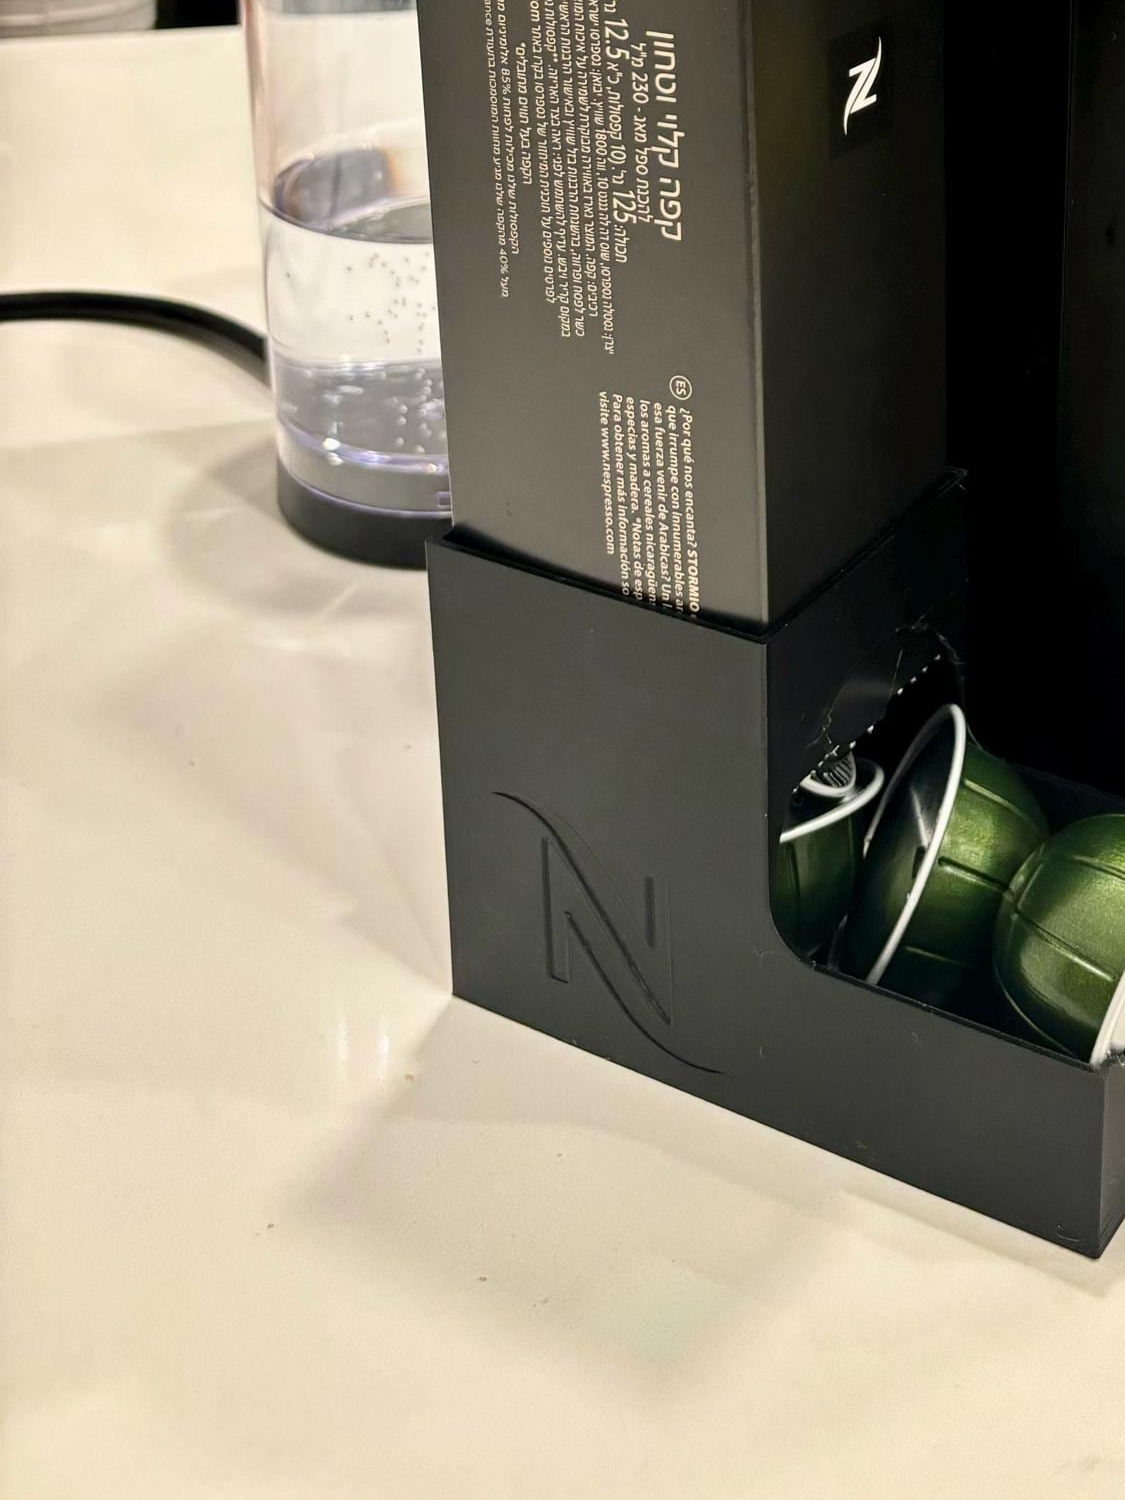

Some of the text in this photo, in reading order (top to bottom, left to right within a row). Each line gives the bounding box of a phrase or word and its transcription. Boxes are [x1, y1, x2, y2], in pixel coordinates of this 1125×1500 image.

[675, 380, 687, 396] ES
[612, 394, 623, 422] Para
[623, 397, 637, 450] especias
[639, 400, 651, 418] los
[653, 402, 663, 424] esa
[614, 424, 624, 475] obtener
[626, 452, 637, 461] y
[641, 420, 650, 467] aromas
[655, 427, 666, 467] fuerza
[599, 391, 614, 554] visite www.nespresso.com
[616, 477, 627, 503] más
[629, 463, 640, 513] madera.
[643, 469, 651, 477] a
[656, 470, 668, 502] venir
[643, 480, 655, 530] cereales
[658, 503, 669, 520] de
[664, 405, 685, 612] que irrumpe con innumerables ar
[679, 408, 699, 612] ¿Por qué nos encanta? STORMIO
[618, 505, 630, 579] información
[659, 522, 671, 582] Arabicas?
[633, 561, 644, 577] de
[661, 584, 672, 601] Un
